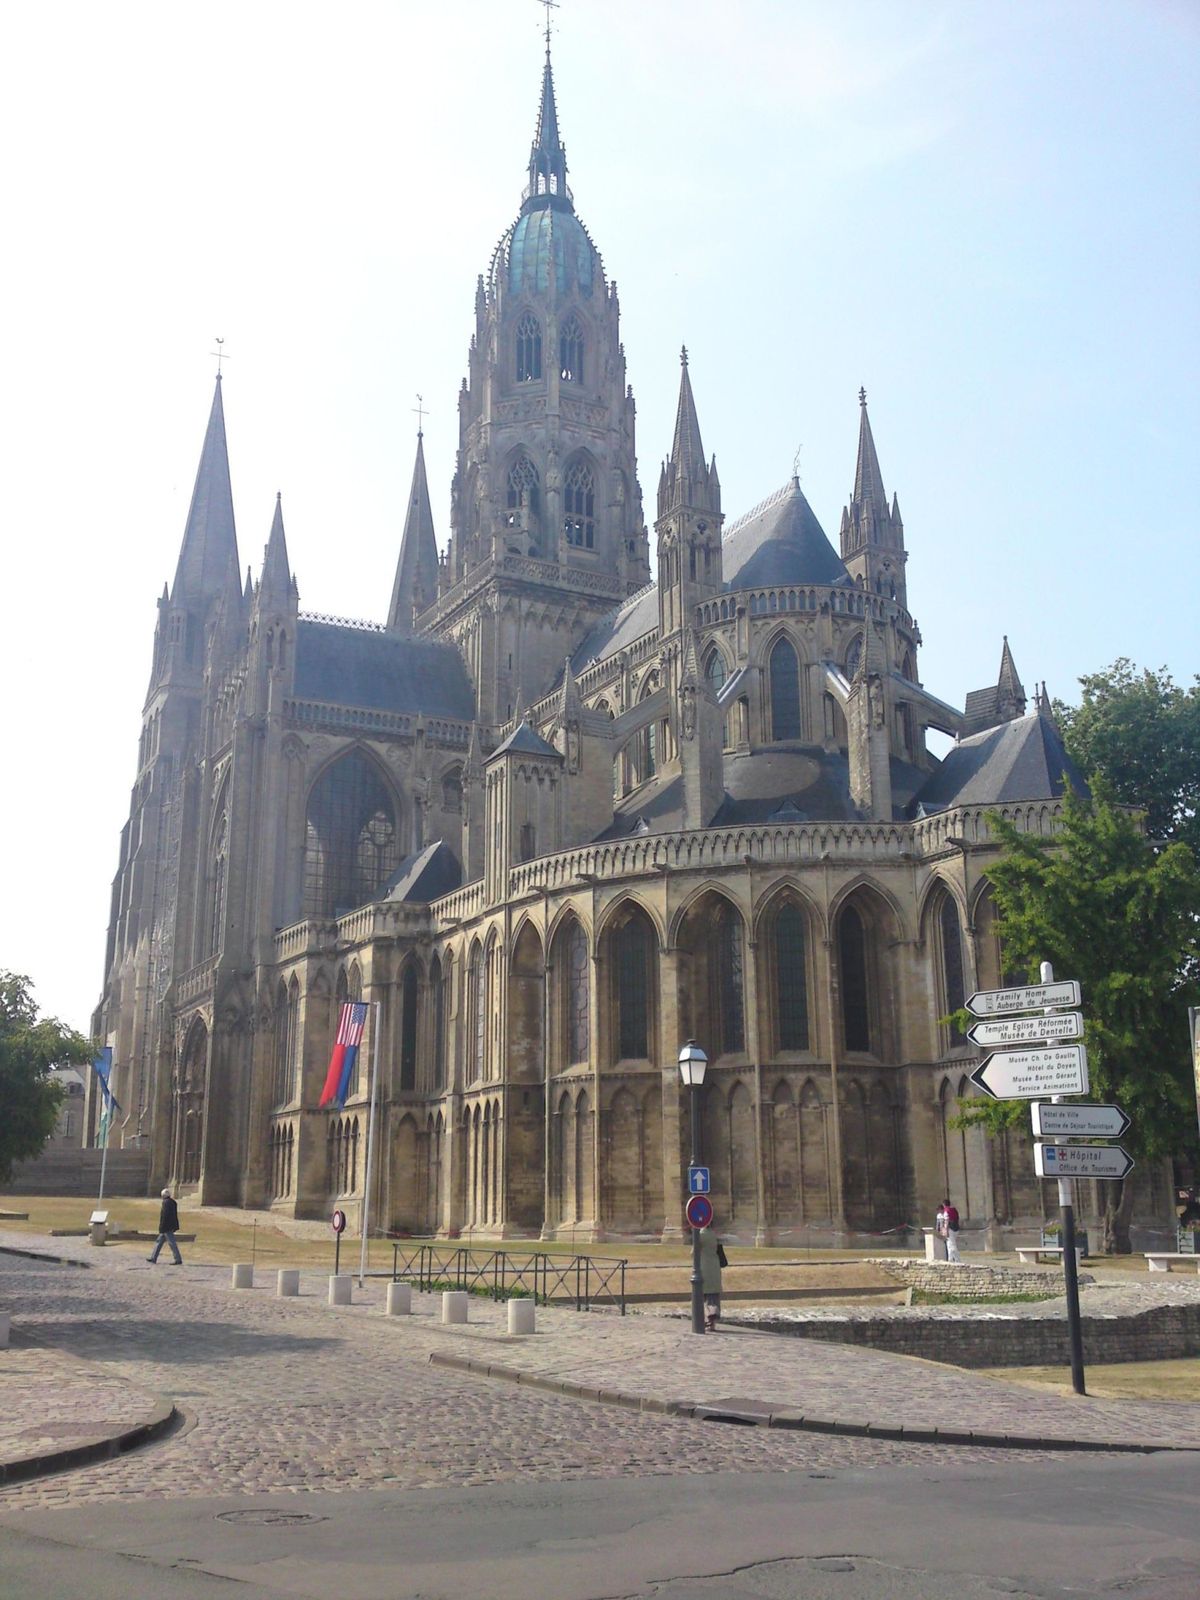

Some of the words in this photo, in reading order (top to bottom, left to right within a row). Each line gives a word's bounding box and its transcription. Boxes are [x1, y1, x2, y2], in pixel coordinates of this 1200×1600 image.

[996, 992, 1020, 1002] Family
[1025, 989, 1046, 998] Home
[996, 1000, 1024, 1010] Auberge
[1027, 998, 1036, 1006] de
[1040, 995, 1070, 1004] Jeunesse
[984, 1024, 1008, 1034] Temple
[1038, 1018, 1072, 1028] Réformée
[1000, 1031, 1024, 1040] Musée
[1040, 1026, 1073, 1036] Dentelle
[1070, 1152, 1102, 1162] Hôpital
